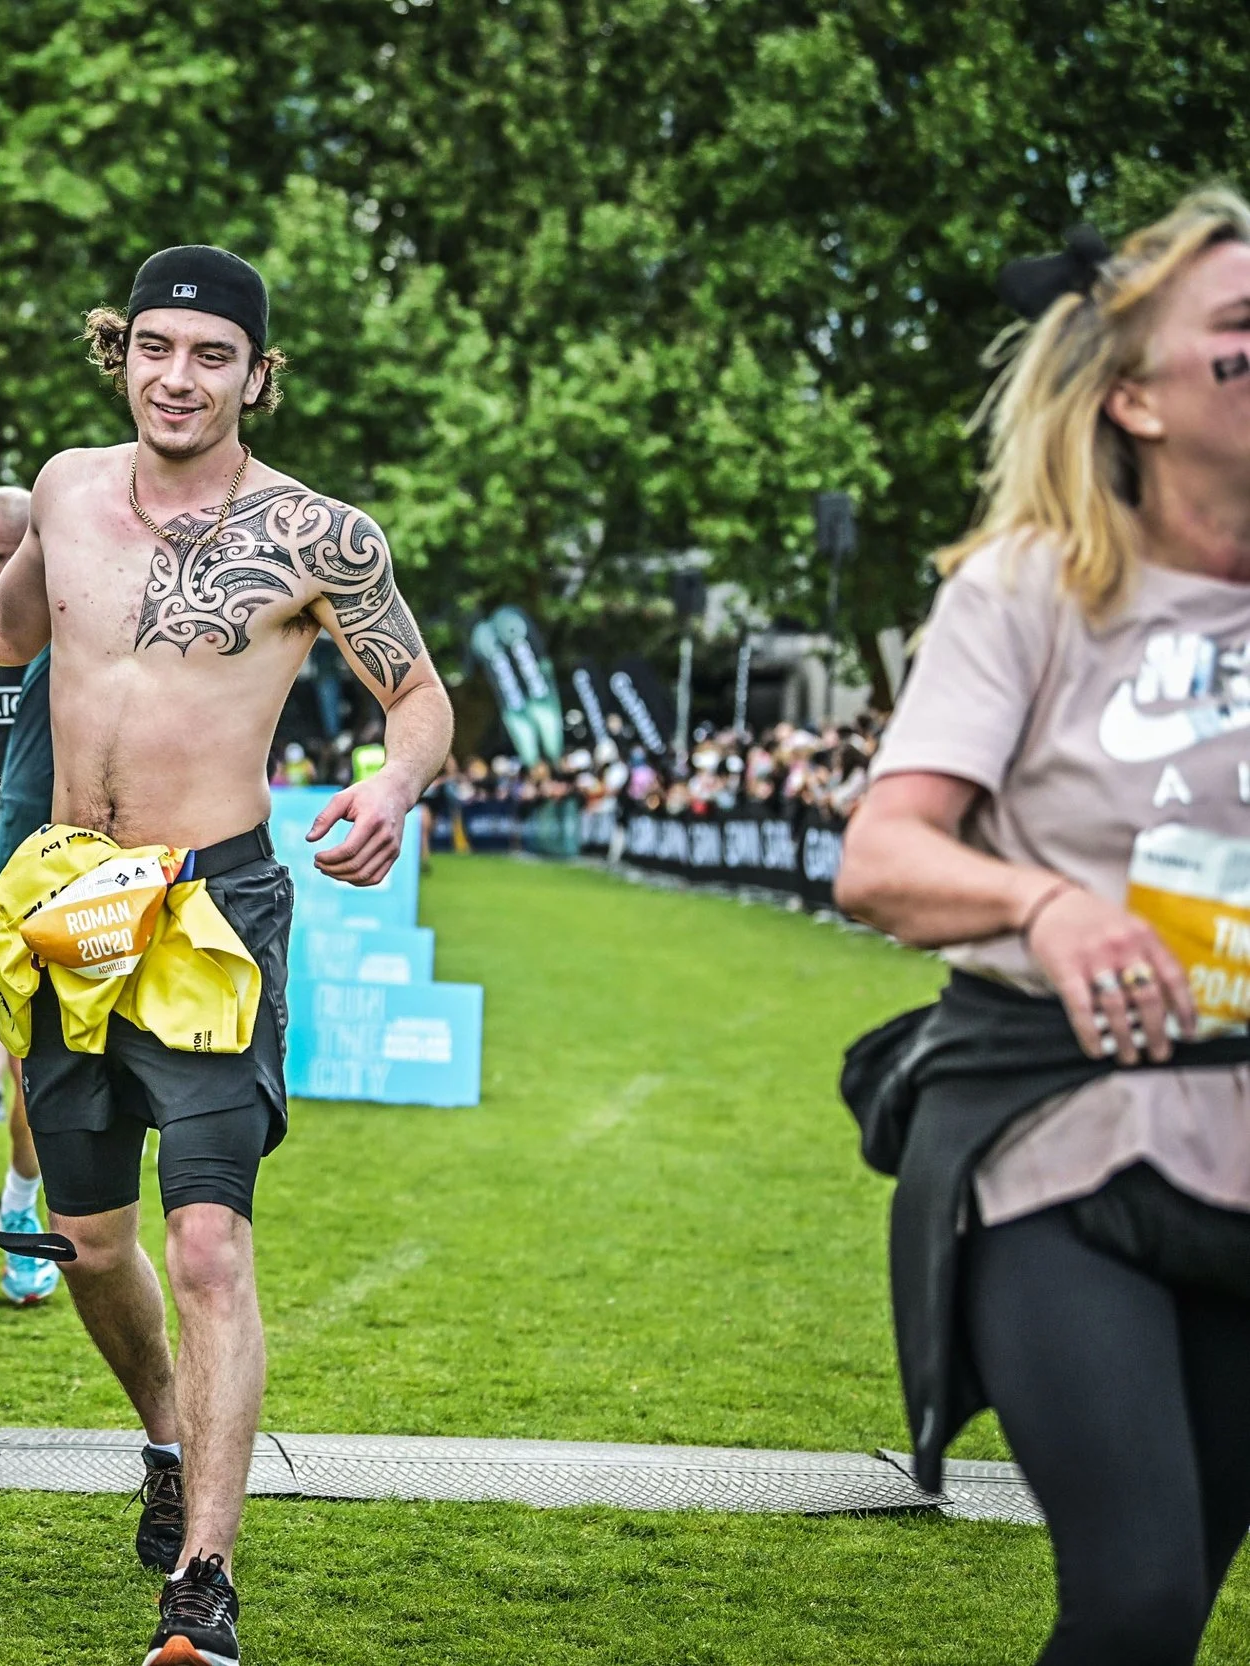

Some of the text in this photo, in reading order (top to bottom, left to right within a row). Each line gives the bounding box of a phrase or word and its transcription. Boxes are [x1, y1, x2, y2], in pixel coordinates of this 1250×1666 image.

[65, 899, 132, 935] ROMAN
[77, 928, 133, 962] 20020
[98, 960, 127, 974] ACHILLES
